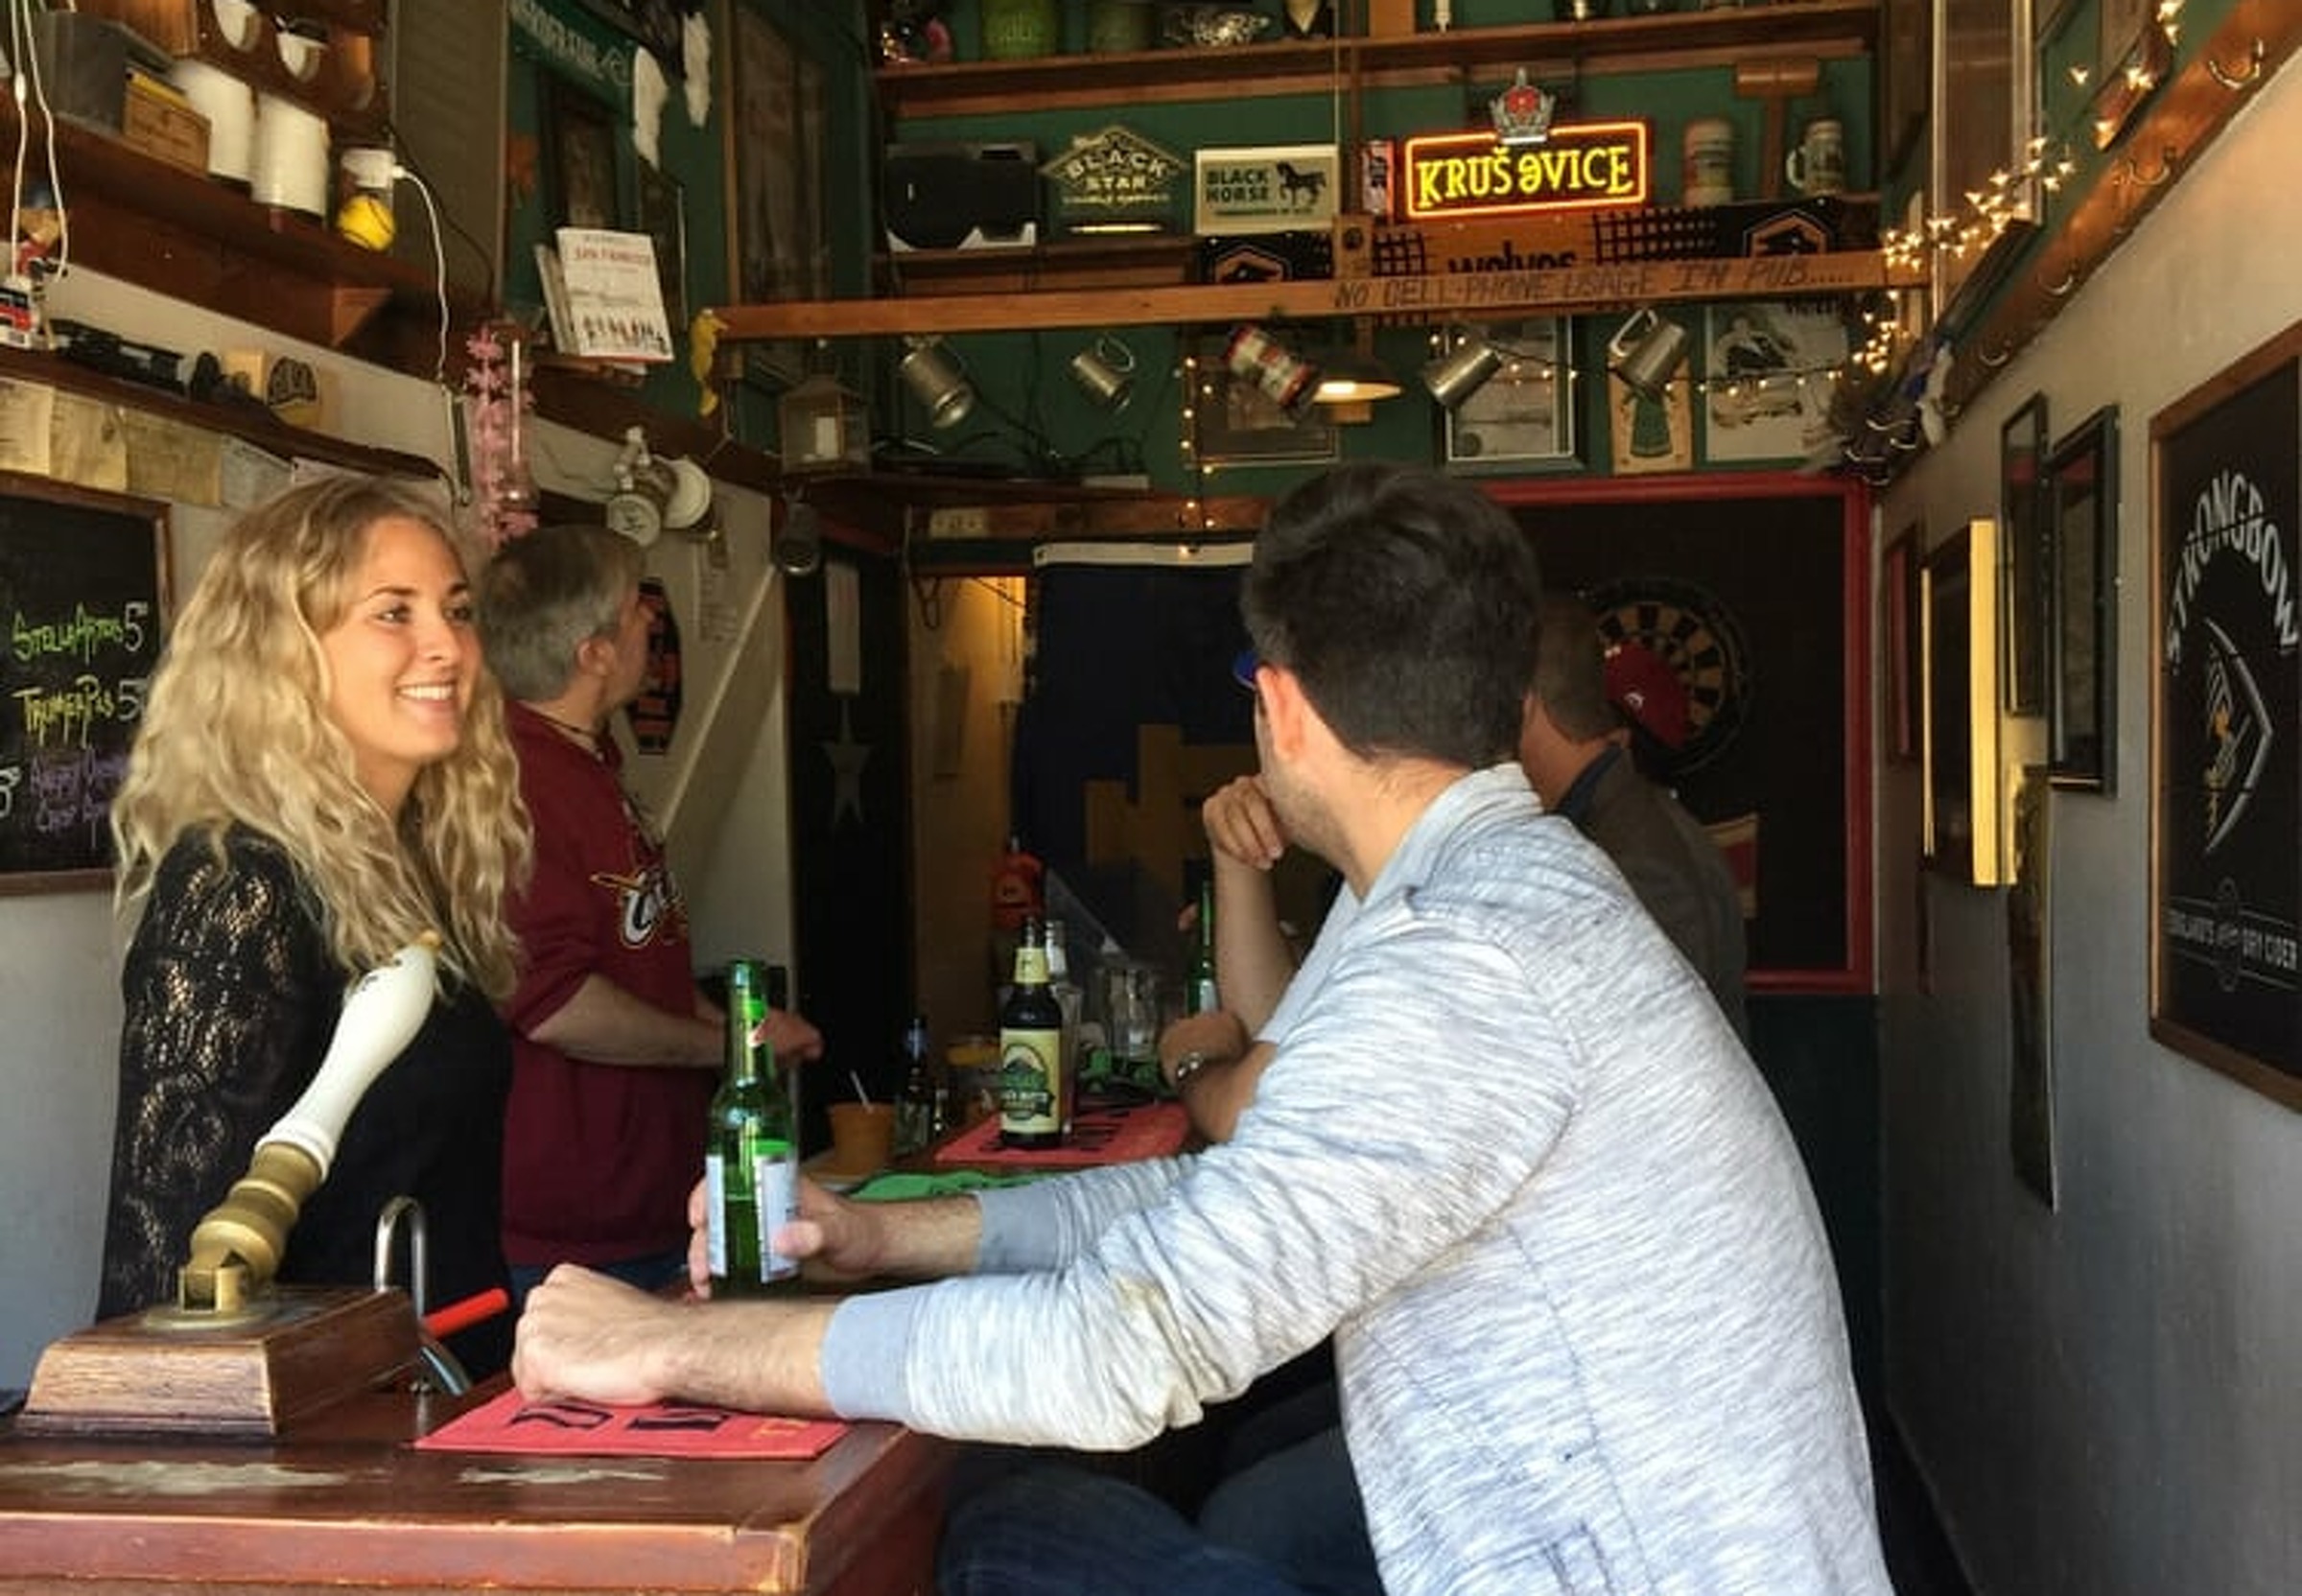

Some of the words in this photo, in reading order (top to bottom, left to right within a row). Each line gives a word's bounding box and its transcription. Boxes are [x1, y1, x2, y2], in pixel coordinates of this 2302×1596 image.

[1067, 149, 1166, 179] BLACK
[1207, 169, 1268, 185] BLACK
[1207, 186, 1268, 203] HORSE
[2169, 469, 2299, 676] STRONGBOW
